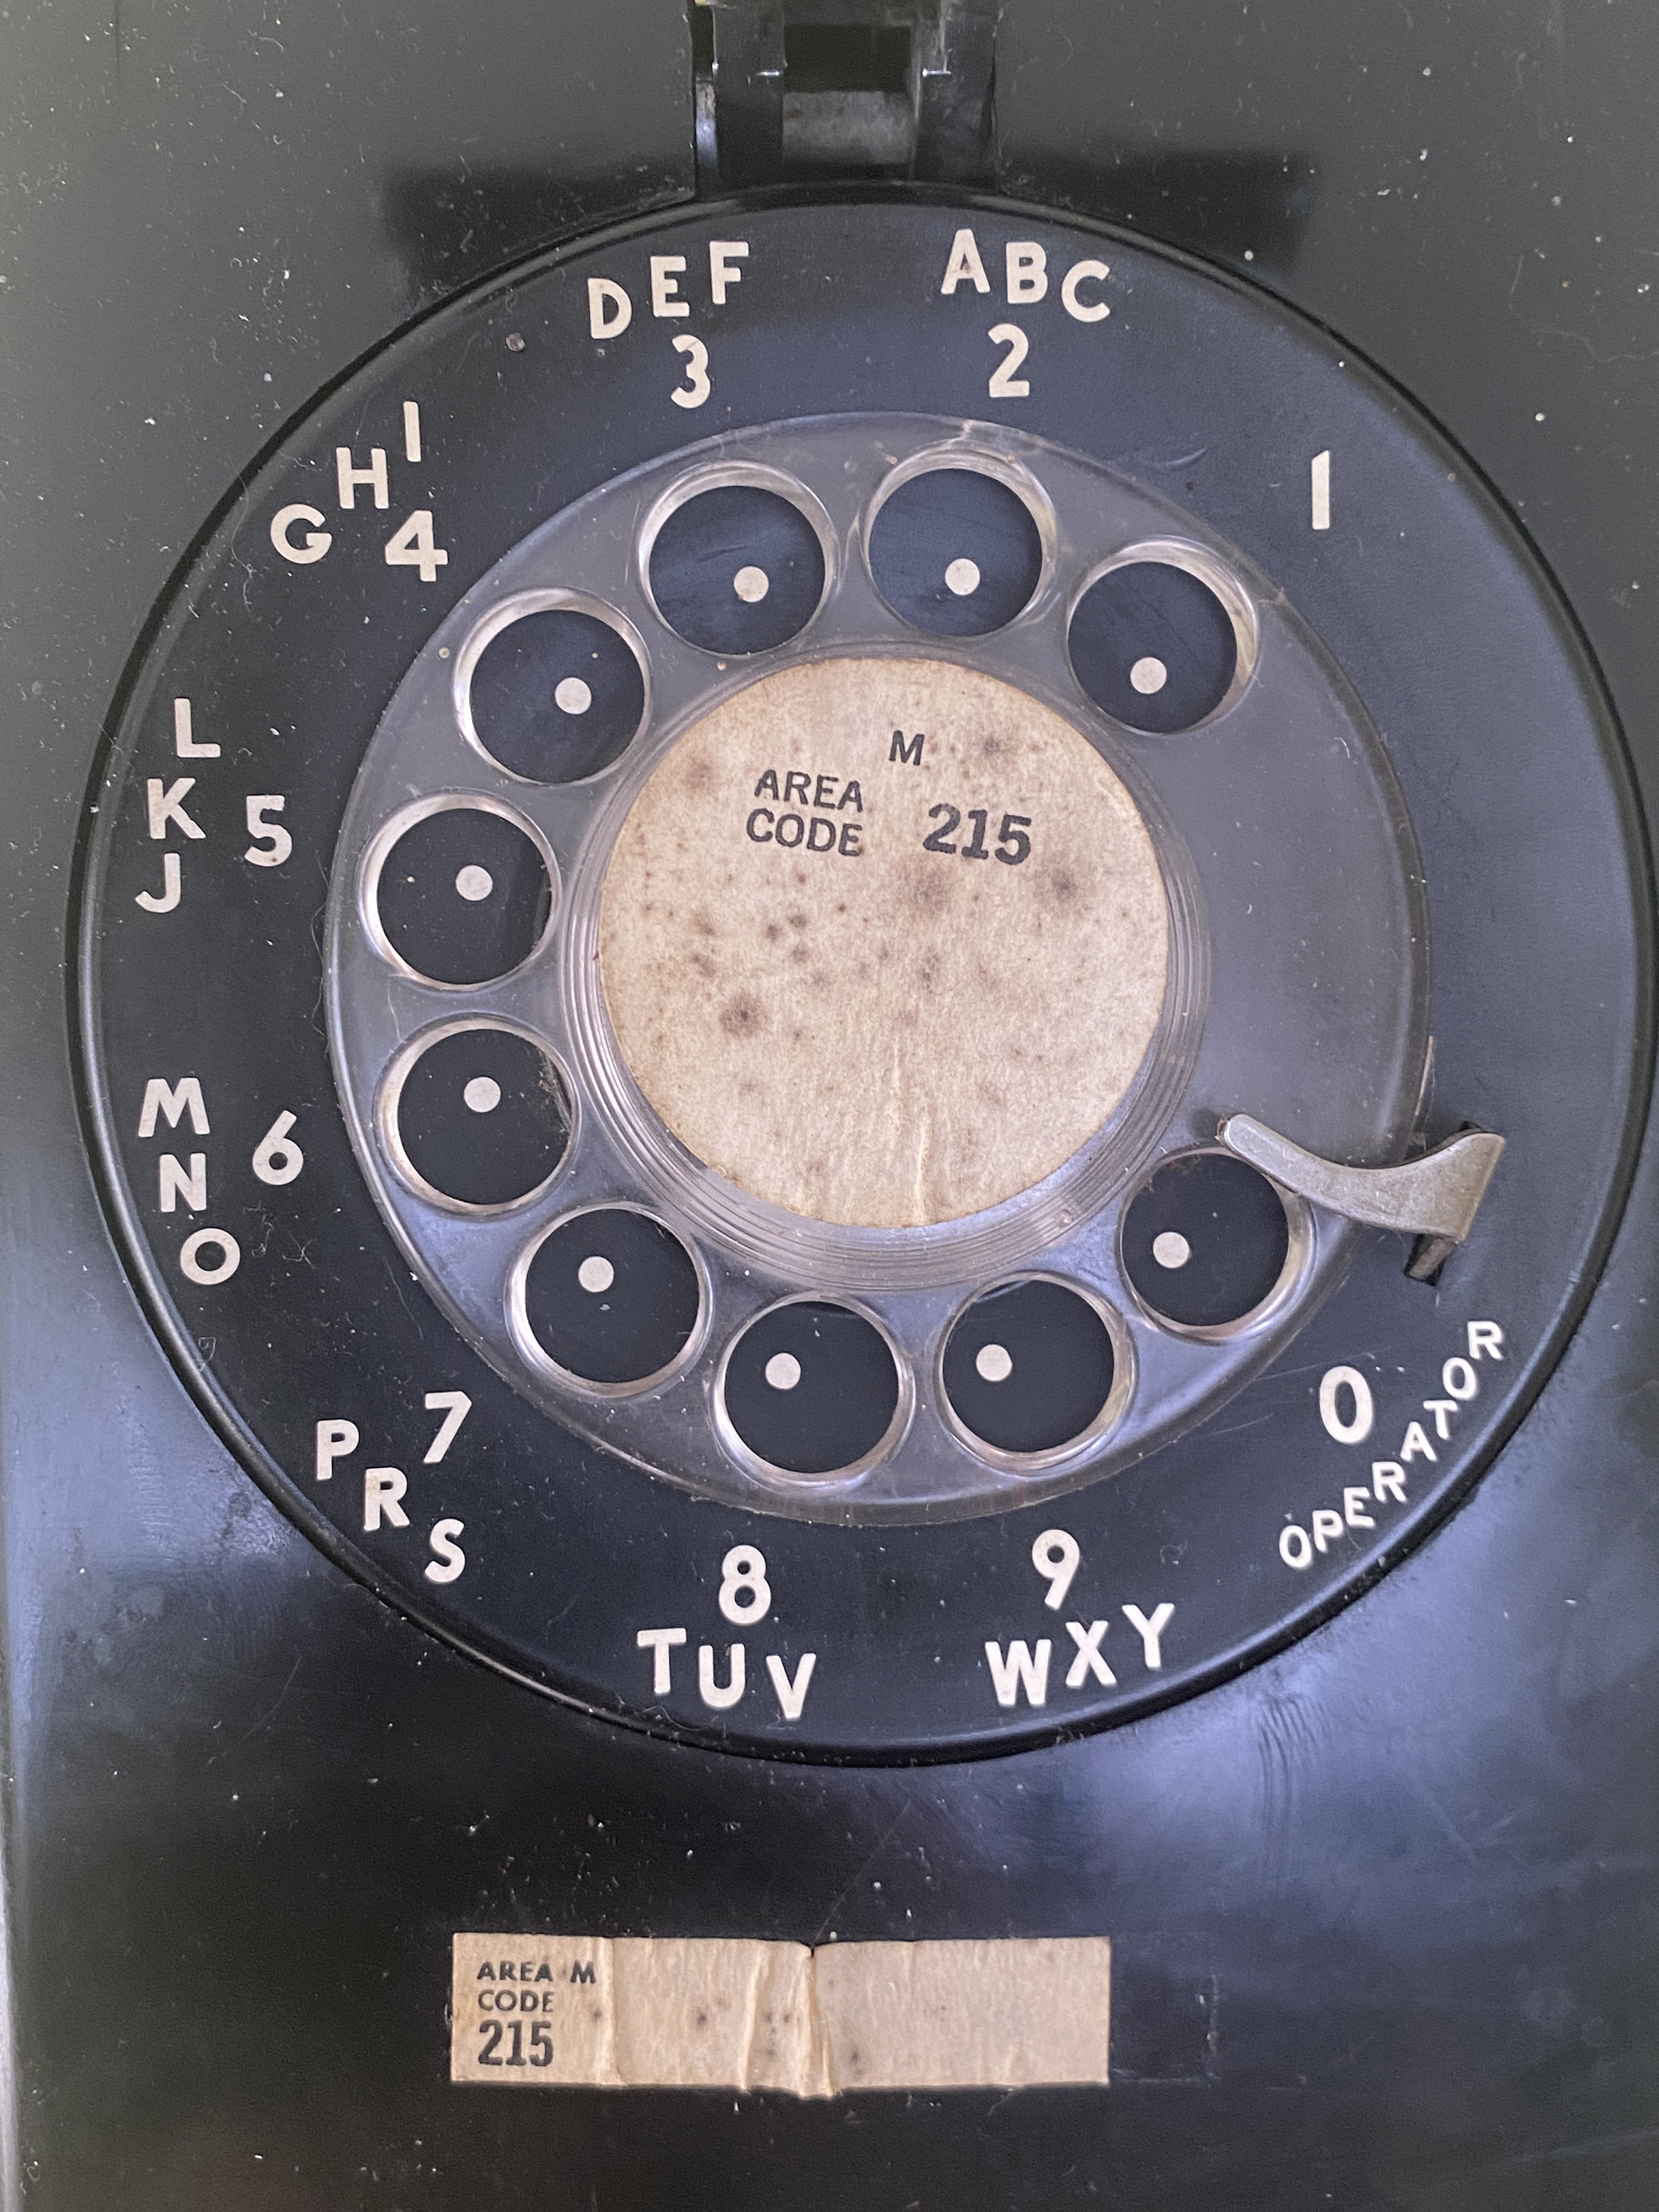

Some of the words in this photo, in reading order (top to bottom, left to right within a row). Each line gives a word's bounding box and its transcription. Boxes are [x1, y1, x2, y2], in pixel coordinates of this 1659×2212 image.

[669, 333, 712, 409] 3
[987, 322, 1031, 399] 2
[383, 509, 449, 583] 4
[888, 729, 925, 766] M
[754, 768, 863, 812] AREA
[243, 793, 293, 868] 5
[746, 807, 863, 857] CODE
[922, 803, 1032, 866] 215
[251, 1109, 305, 1186] 6
[422, 1390, 473, 1465] 7
[1278, 1320, 1505, 1571] OPERATOR
[717, 1544, 773, 1627] 8
[1031, 1528, 1081, 1612] 9
[476, 1960, 554, 1983] AREA
[569, 1960, 597, 1984] M
[477, 1989, 554, 2014] CODE
[477, 2019, 554, 2067] 215
